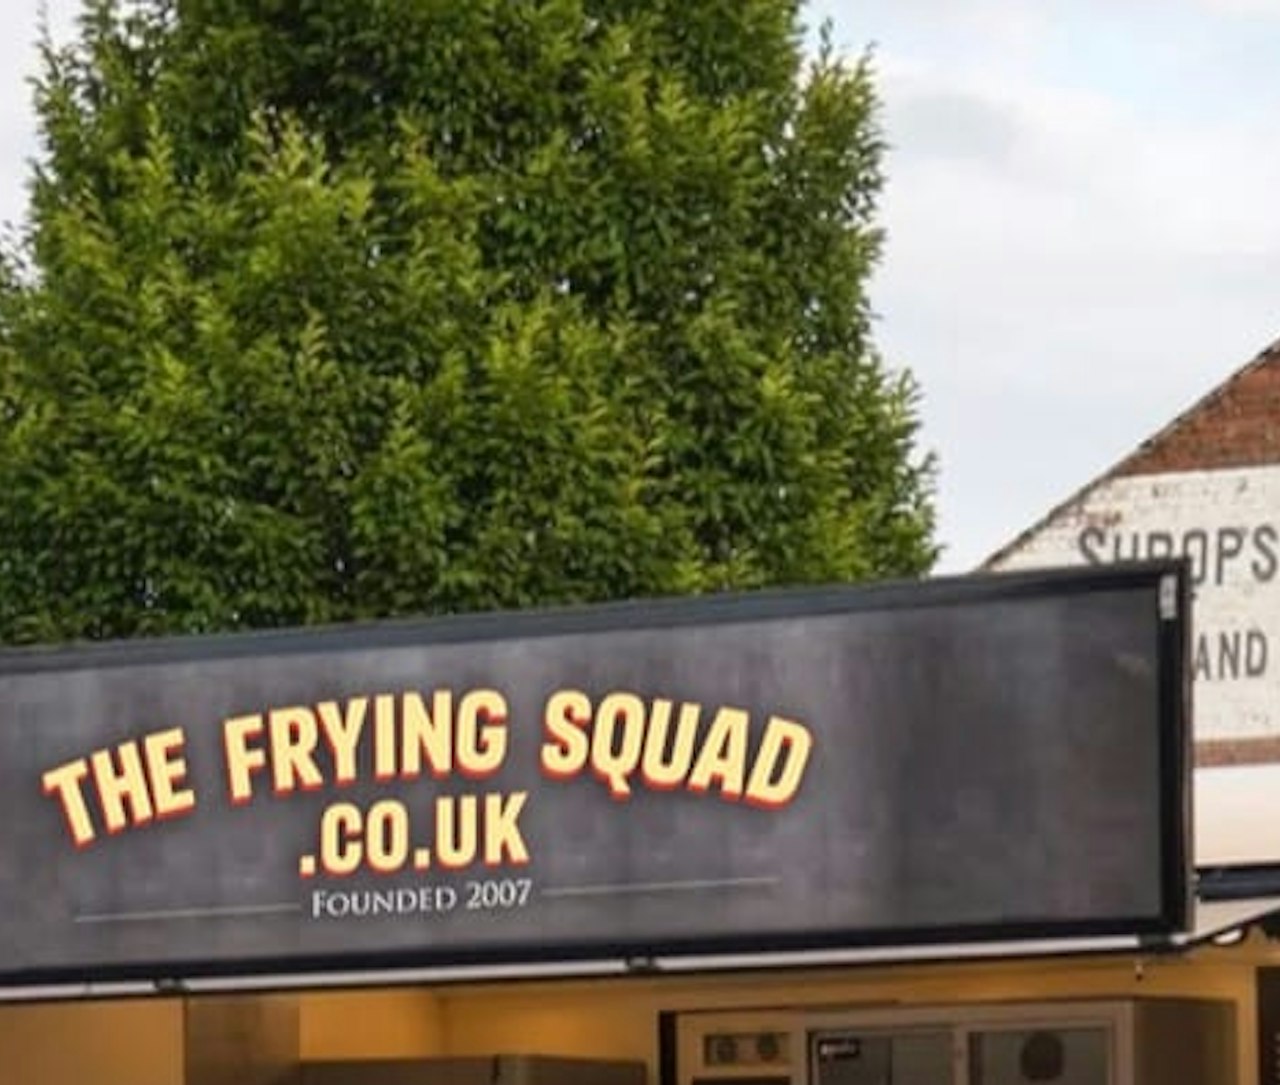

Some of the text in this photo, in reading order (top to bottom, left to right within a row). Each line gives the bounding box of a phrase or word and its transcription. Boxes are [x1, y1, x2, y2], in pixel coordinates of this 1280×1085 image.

[1194, 629, 1268, 681] AND
[41, 688, 815, 849] THE FRYING SQUAD
[298, 789, 531, 880] .CO.UK
[311, 878, 533, 919] FOUNDED 2007
